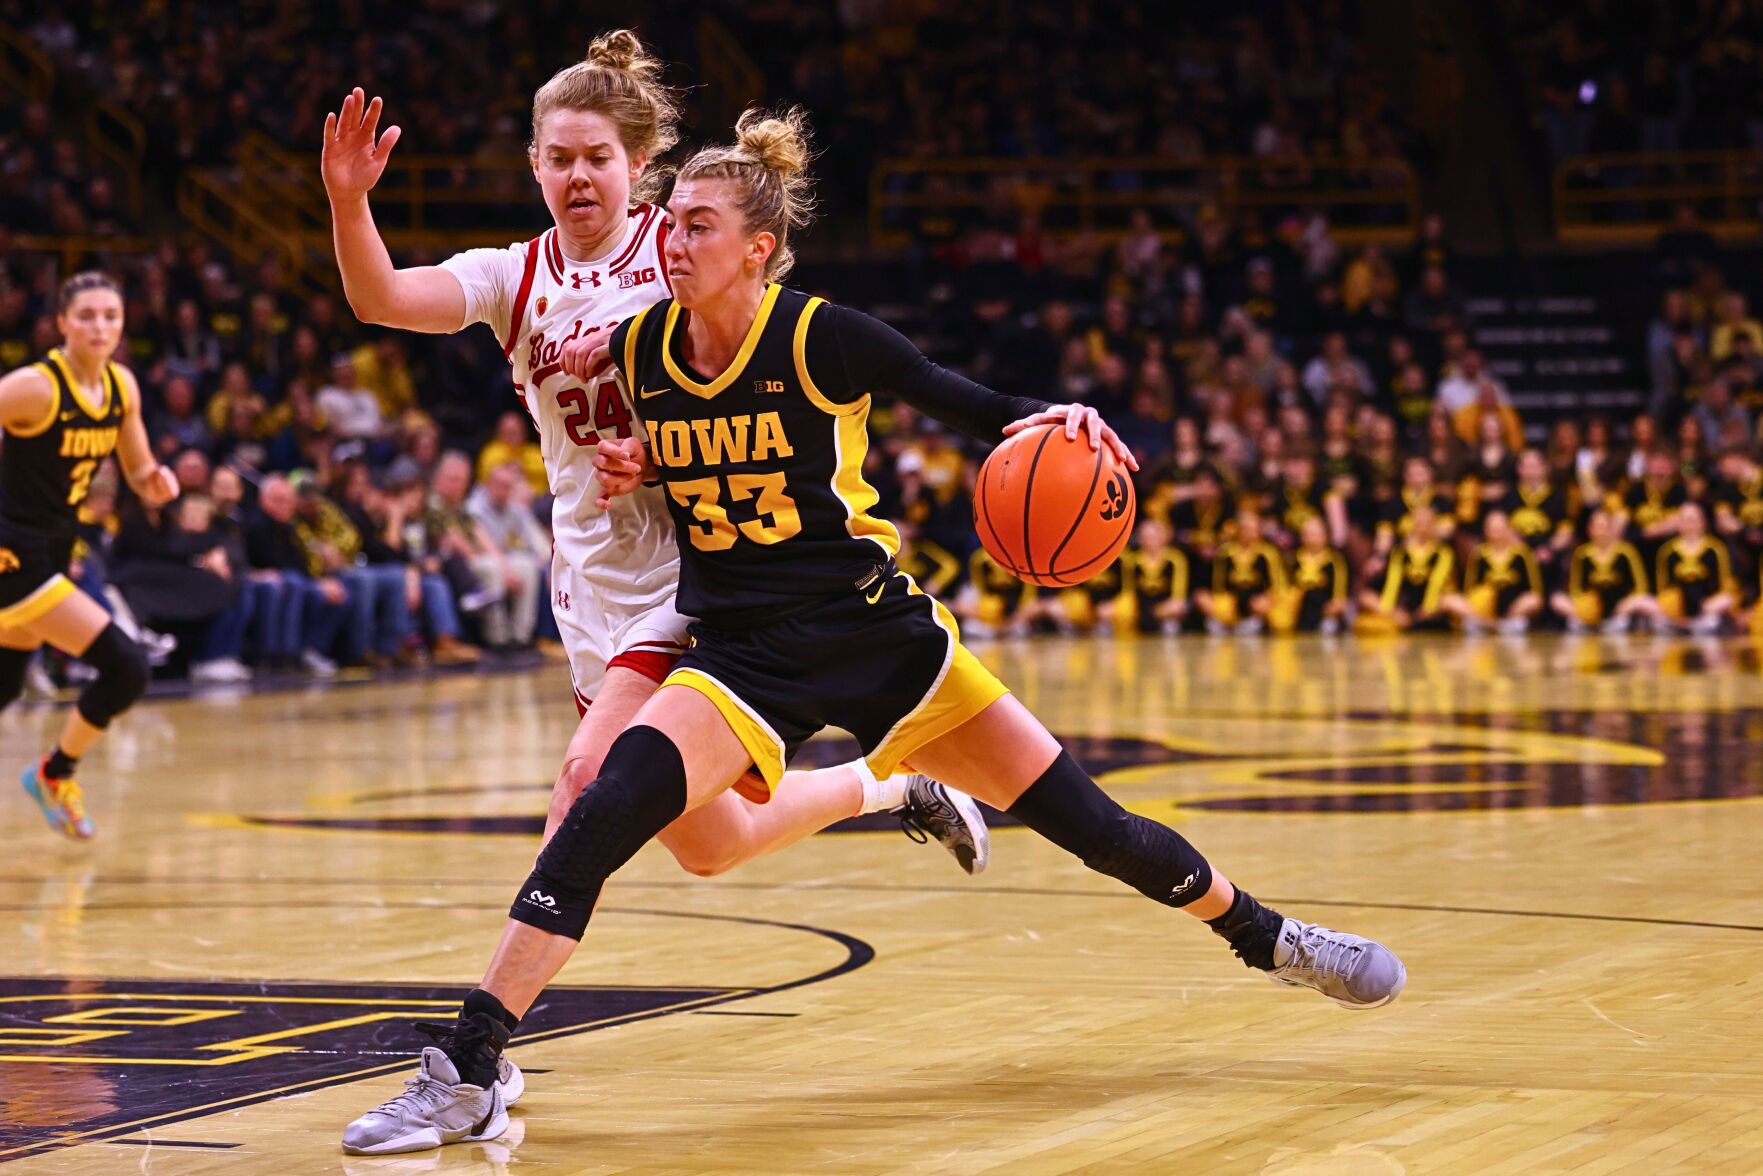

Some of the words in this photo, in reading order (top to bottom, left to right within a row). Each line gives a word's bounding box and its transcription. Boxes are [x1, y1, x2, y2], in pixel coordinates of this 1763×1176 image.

[556, 381, 633, 447] 24
[645, 411, 794, 468] IOWA
[666, 471, 803, 552] 33
